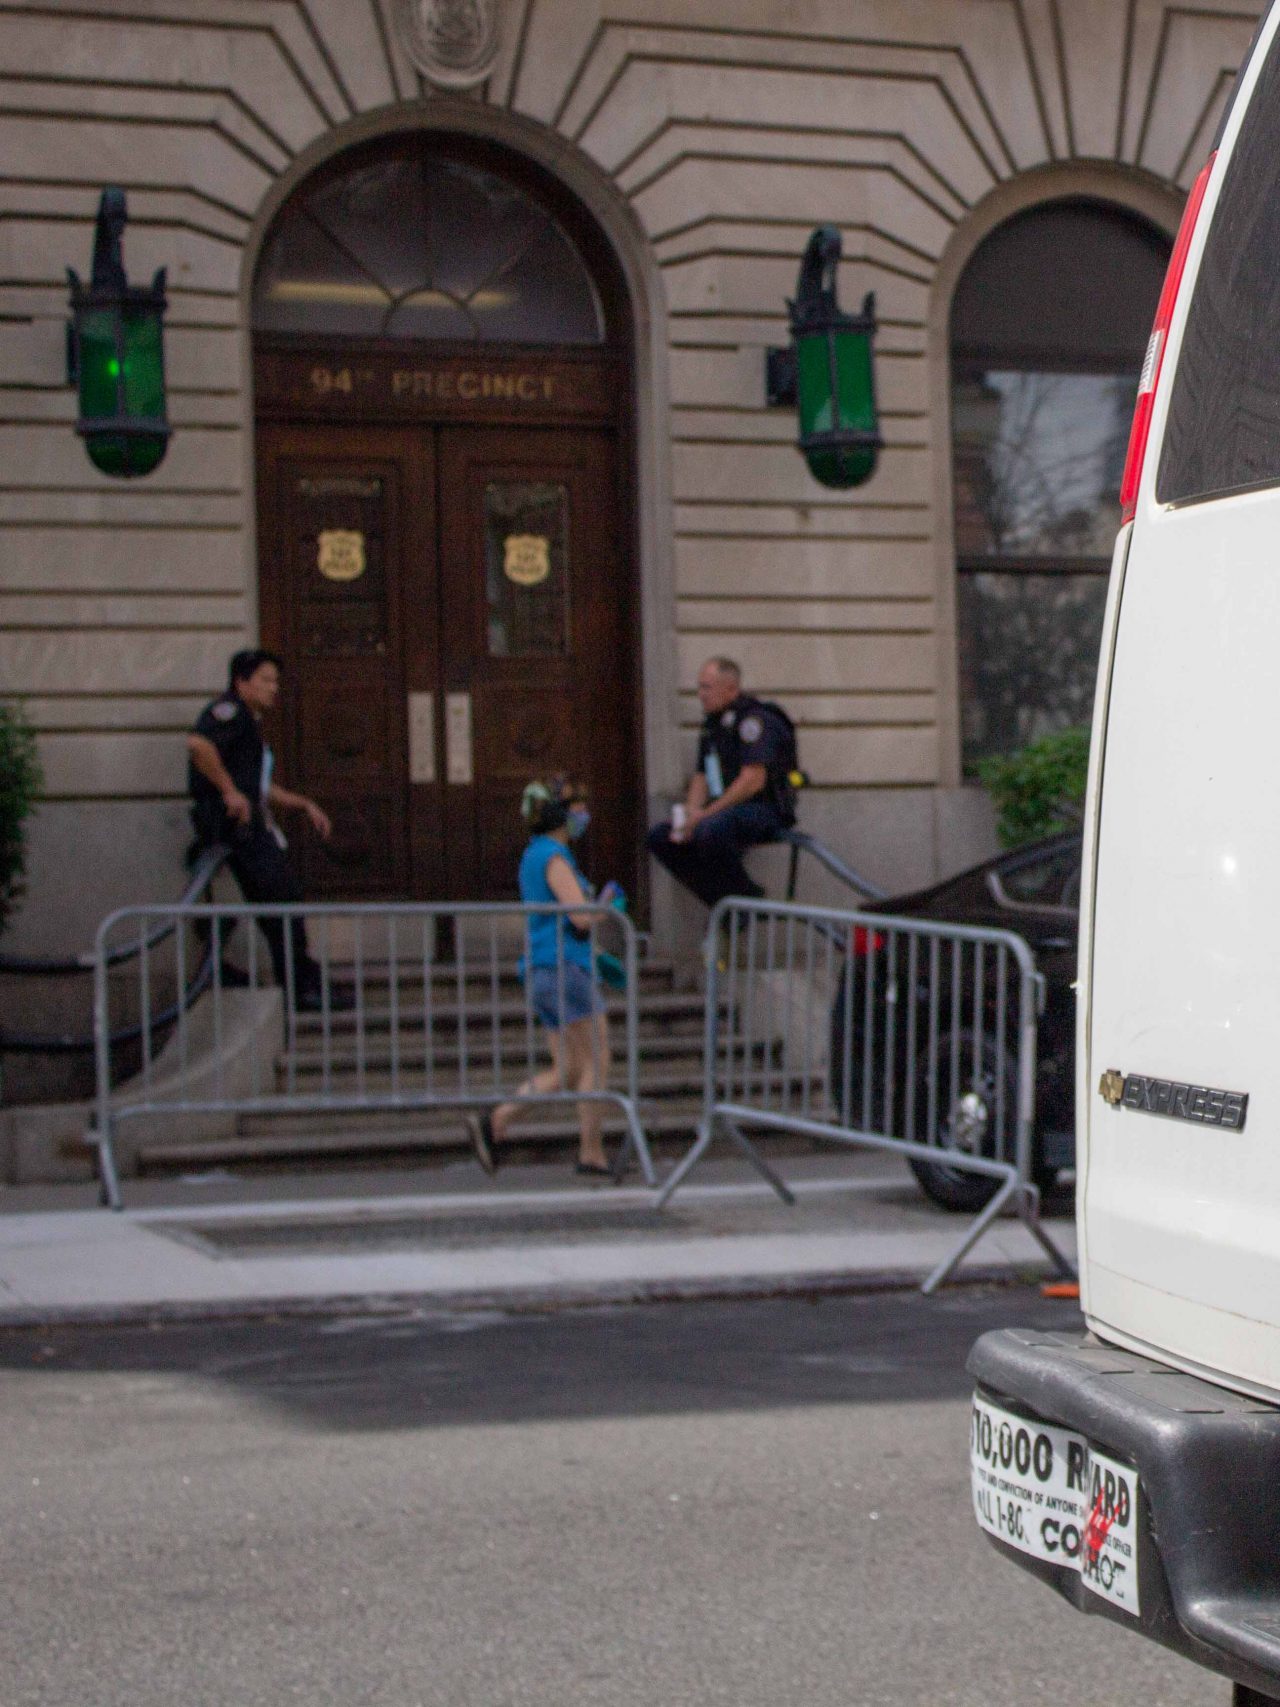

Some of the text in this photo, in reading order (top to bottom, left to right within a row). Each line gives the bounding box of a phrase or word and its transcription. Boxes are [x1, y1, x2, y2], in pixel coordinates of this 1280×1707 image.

[391, 369, 557, 400] PRECINCT
[1122, 1073, 1245, 1129] EXPRESS
[970, 1404, 1053, 1482] 10,000
[998, 1478, 1032, 1504] CONVICTION
[1034, 1491, 1044, 1506] OF
[1045, 1496, 1078, 1517] ANYONE
[1112, 1536, 1132, 1558] OFFICER
